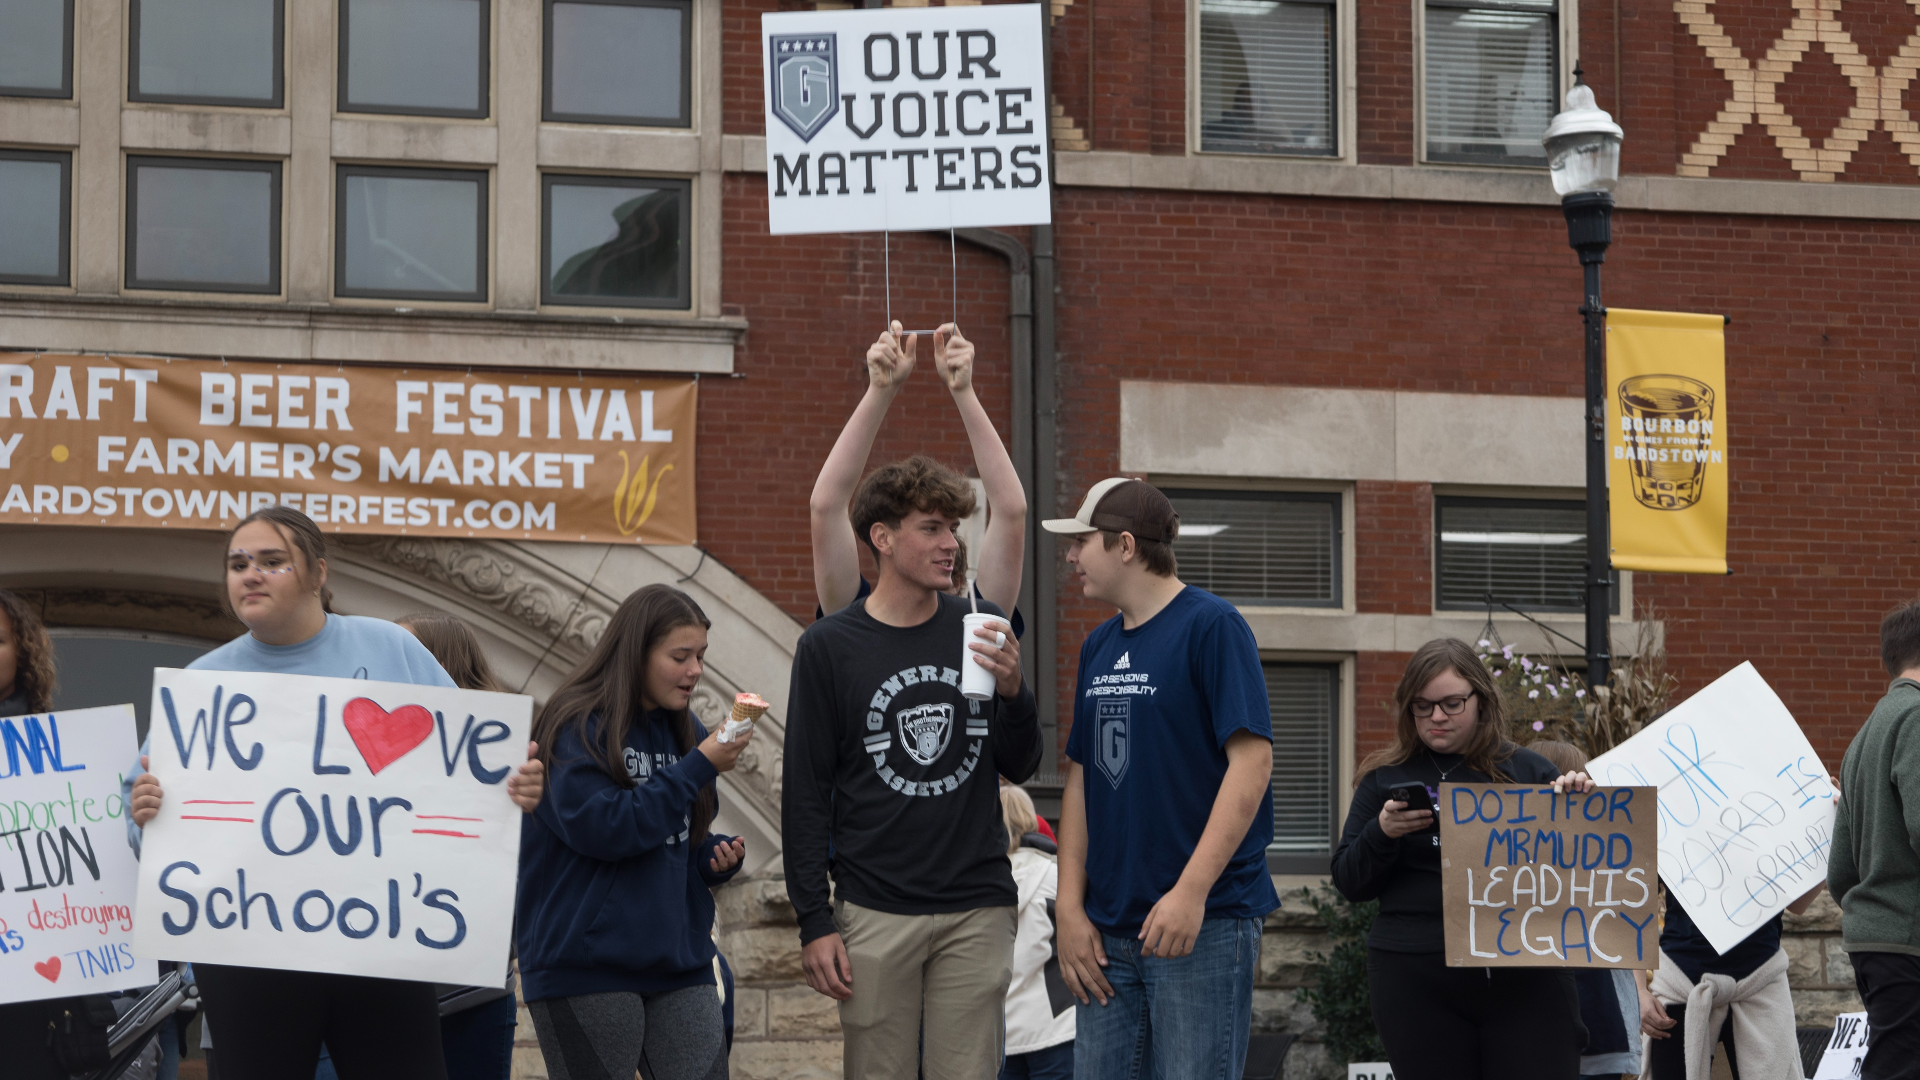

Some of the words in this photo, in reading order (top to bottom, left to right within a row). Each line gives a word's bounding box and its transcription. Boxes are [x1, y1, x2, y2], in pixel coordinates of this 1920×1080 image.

[863, 29, 1000, 82] OUR
[841, 88, 1033, 140] VOICE
[773, 145, 1042, 197] MATTERS
[0, 364, 158, 422] RAFT
[199, 372, 353, 431] BEER
[395, 380, 673, 443] FESTIVAL
[1621, 416, 1714, 434] BOURBON
[98, 436, 361, 482] FARMER'S
[378, 446, 594, 489] MARKET
[1614, 446, 1722, 464] BARDSTOWN
[1635, 435, 1662, 445] COMES
[1666, 436, 1698, 445] FROM
[866, 665, 981, 731] GENERAS
[1092, 675, 1108, 685] OUR
[1108, 674, 1140, 683] SEASON
[161, 685, 263, 771] We
[873, 738, 983, 797] BASKETBALL
[1777, 756, 1833, 809] IS
[1451, 787, 1503, 824] DO
[1504, 788, 1560, 822] IT
[1566, 787, 1633, 825] FOR
[0, 825, 101, 893] ION
[1533, 829, 1633, 870] MUDD
[158, 861, 467, 949] School's
[1467, 864, 1562, 907] LEAD
[1570, 868, 1650, 908] HIS
[27, 892, 133, 935] destroying
[1469, 906, 1654, 963] LEGACY
[64, 942, 135, 979] TNHS
[1831, 1017, 1862, 1050] WE
